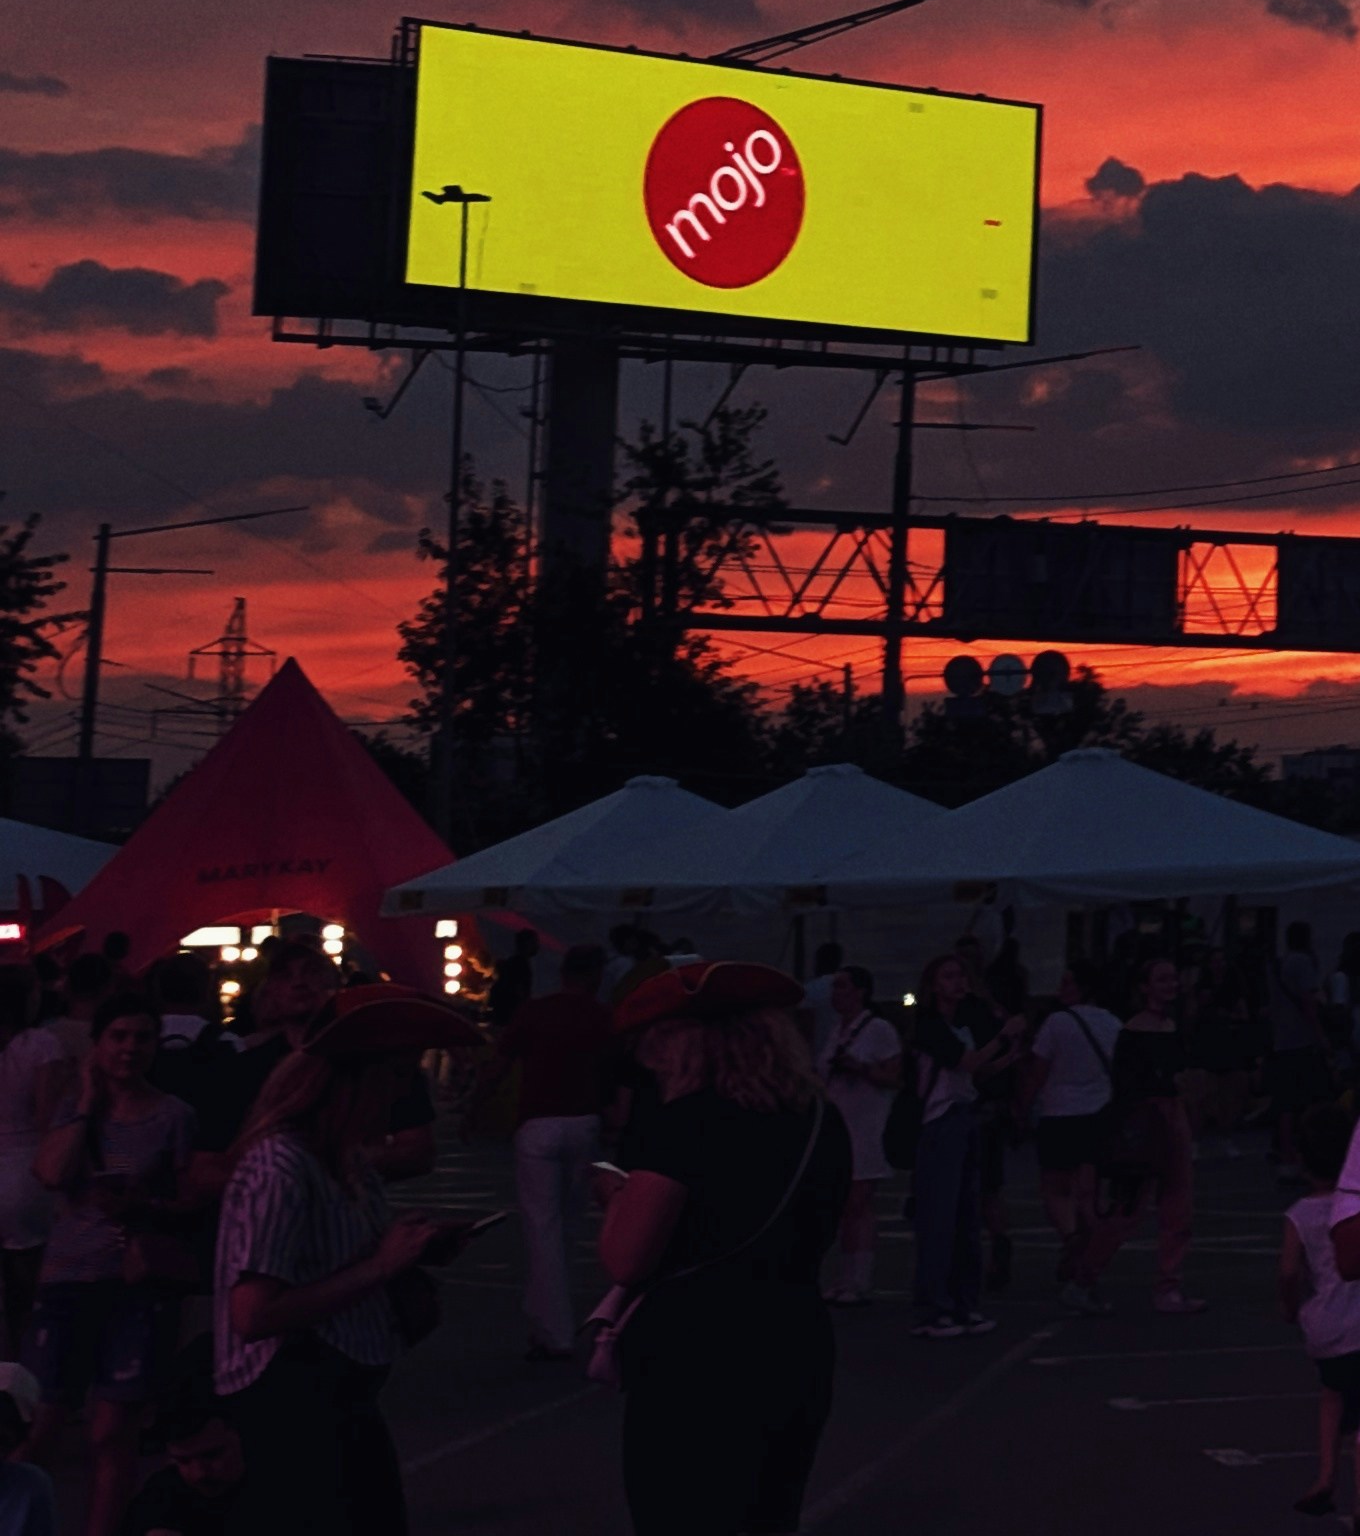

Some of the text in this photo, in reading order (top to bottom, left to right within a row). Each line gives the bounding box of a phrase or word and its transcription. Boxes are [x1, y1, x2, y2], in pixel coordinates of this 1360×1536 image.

[664, 129, 782, 259] mojo
[198, 858, 332, 883] MARY KAY
